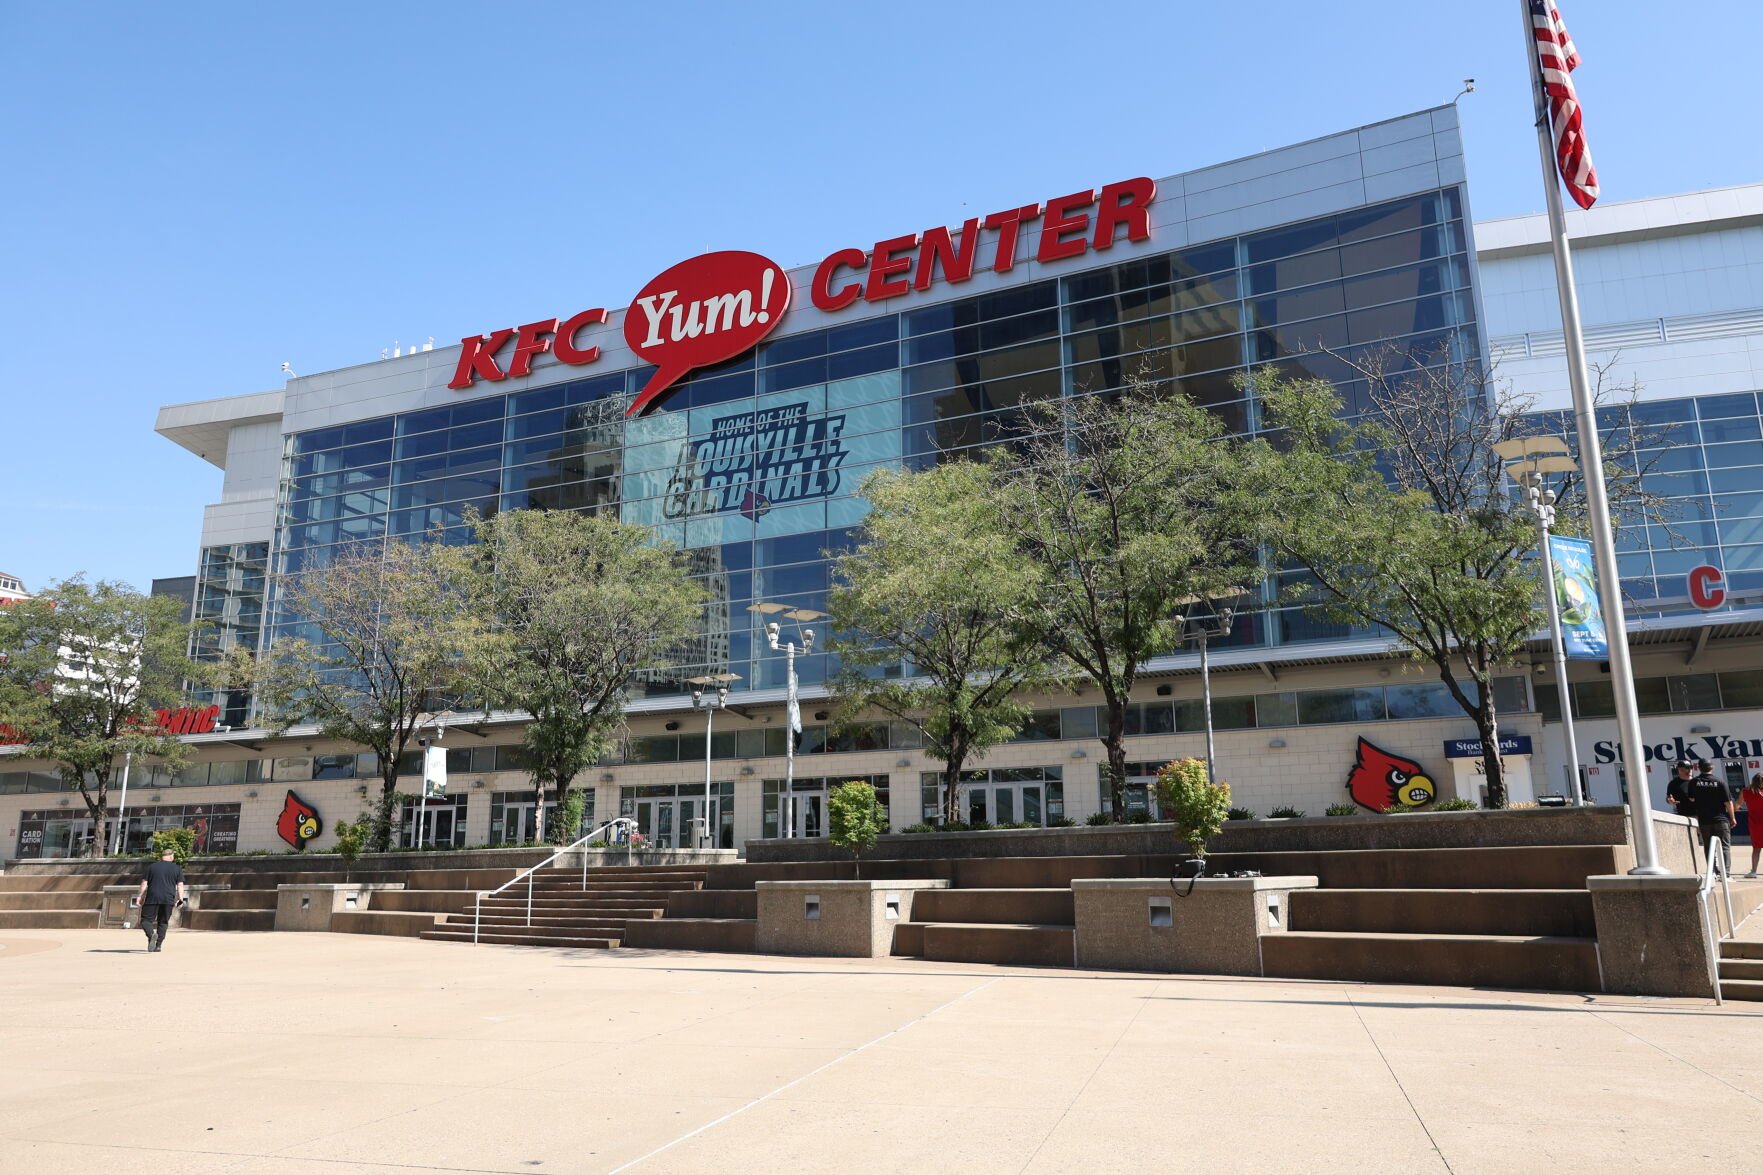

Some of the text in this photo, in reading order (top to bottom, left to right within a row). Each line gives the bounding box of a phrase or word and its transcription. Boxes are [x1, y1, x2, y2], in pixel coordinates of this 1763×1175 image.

[448, 176, 1157, 390] KFC Yum! CENTER
[674, 418, 844, 477] LOUISVILLE
[716, 406, 803, 438] HOME OF THE
[666, 455, 842, 515] CARDINALS
[1688, 565, 1726, 610] C
[22, 830, 42, 838] CARD
